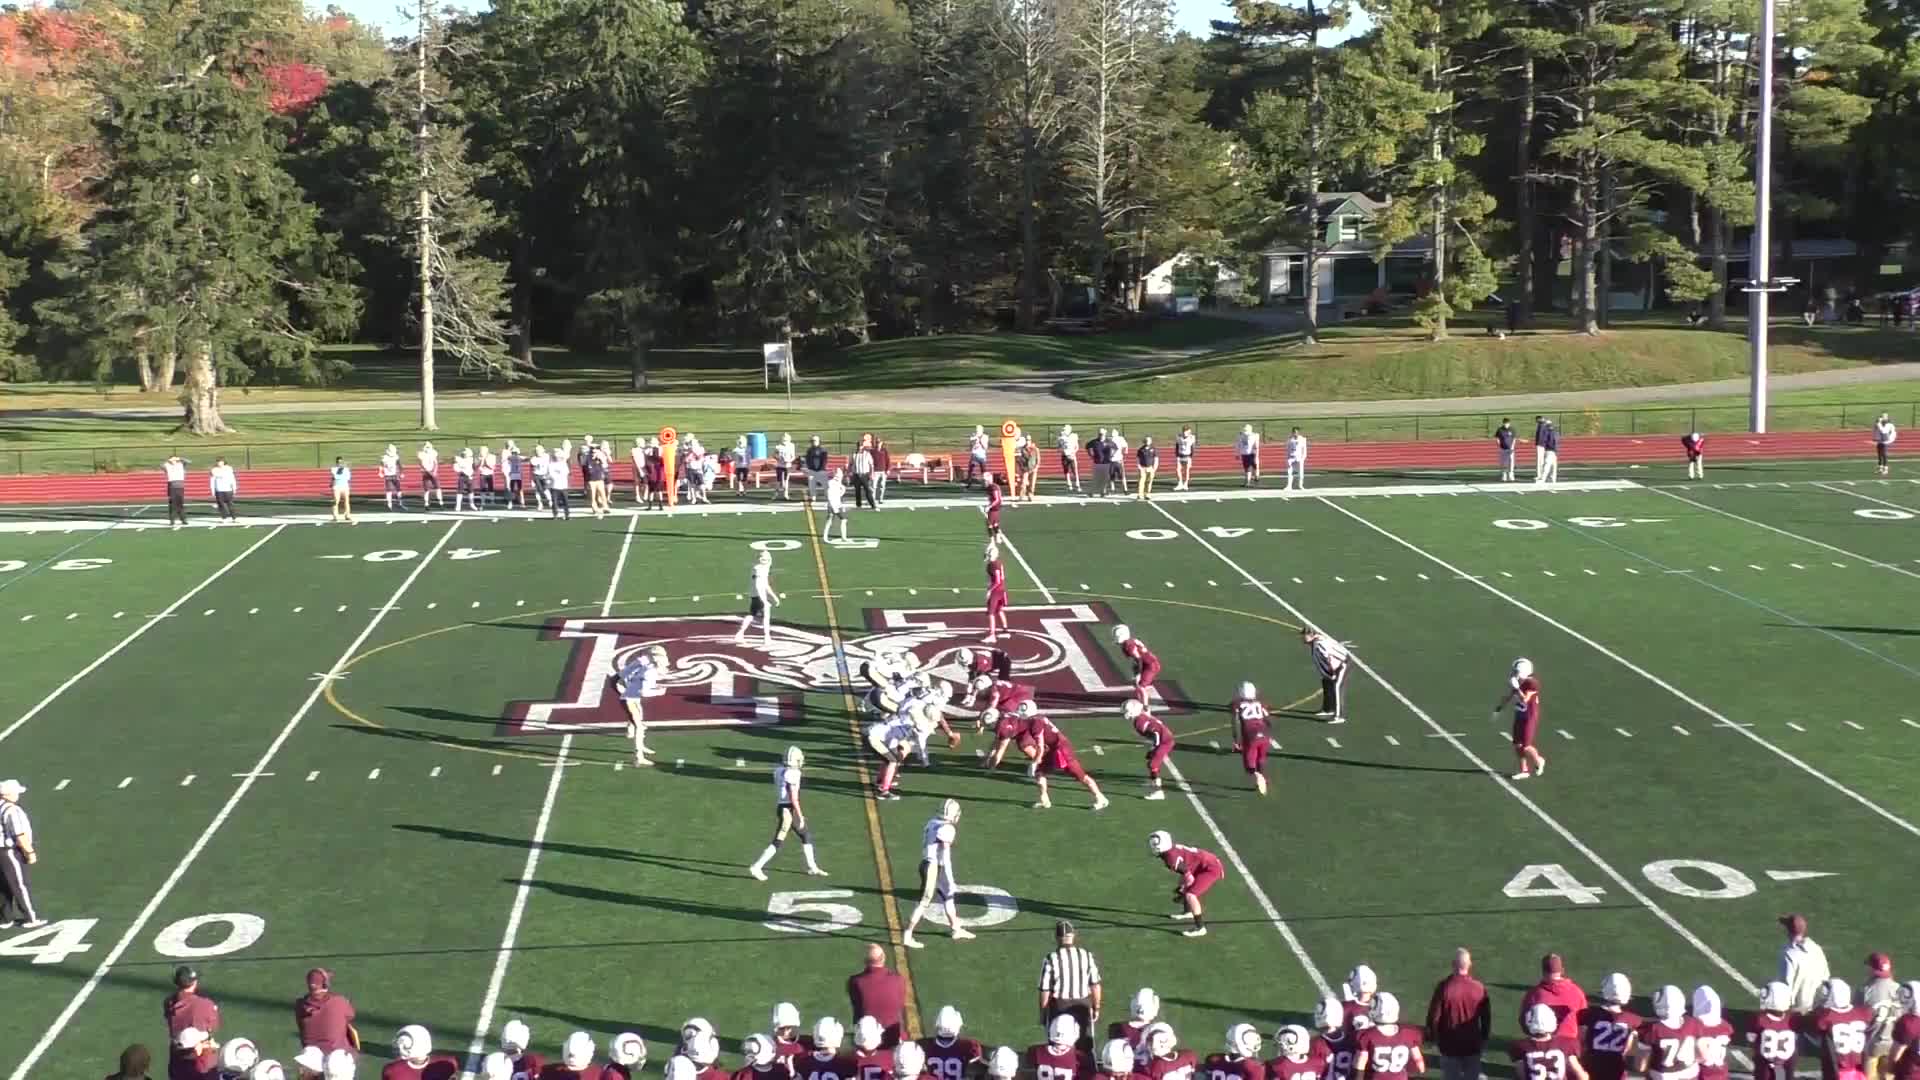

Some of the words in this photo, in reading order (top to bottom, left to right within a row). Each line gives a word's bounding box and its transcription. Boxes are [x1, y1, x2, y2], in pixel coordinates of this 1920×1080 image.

[1239, 701, 1265, 720] 20
[1592, 1020, 1629, 1051] 22
[1372, 1045, 1409, 1072] 58
[1525, 1049, 1566, 1080] 53
[1659, 1035, 1696, 1067] 74
[927, 1056, 963, 1080] 39
